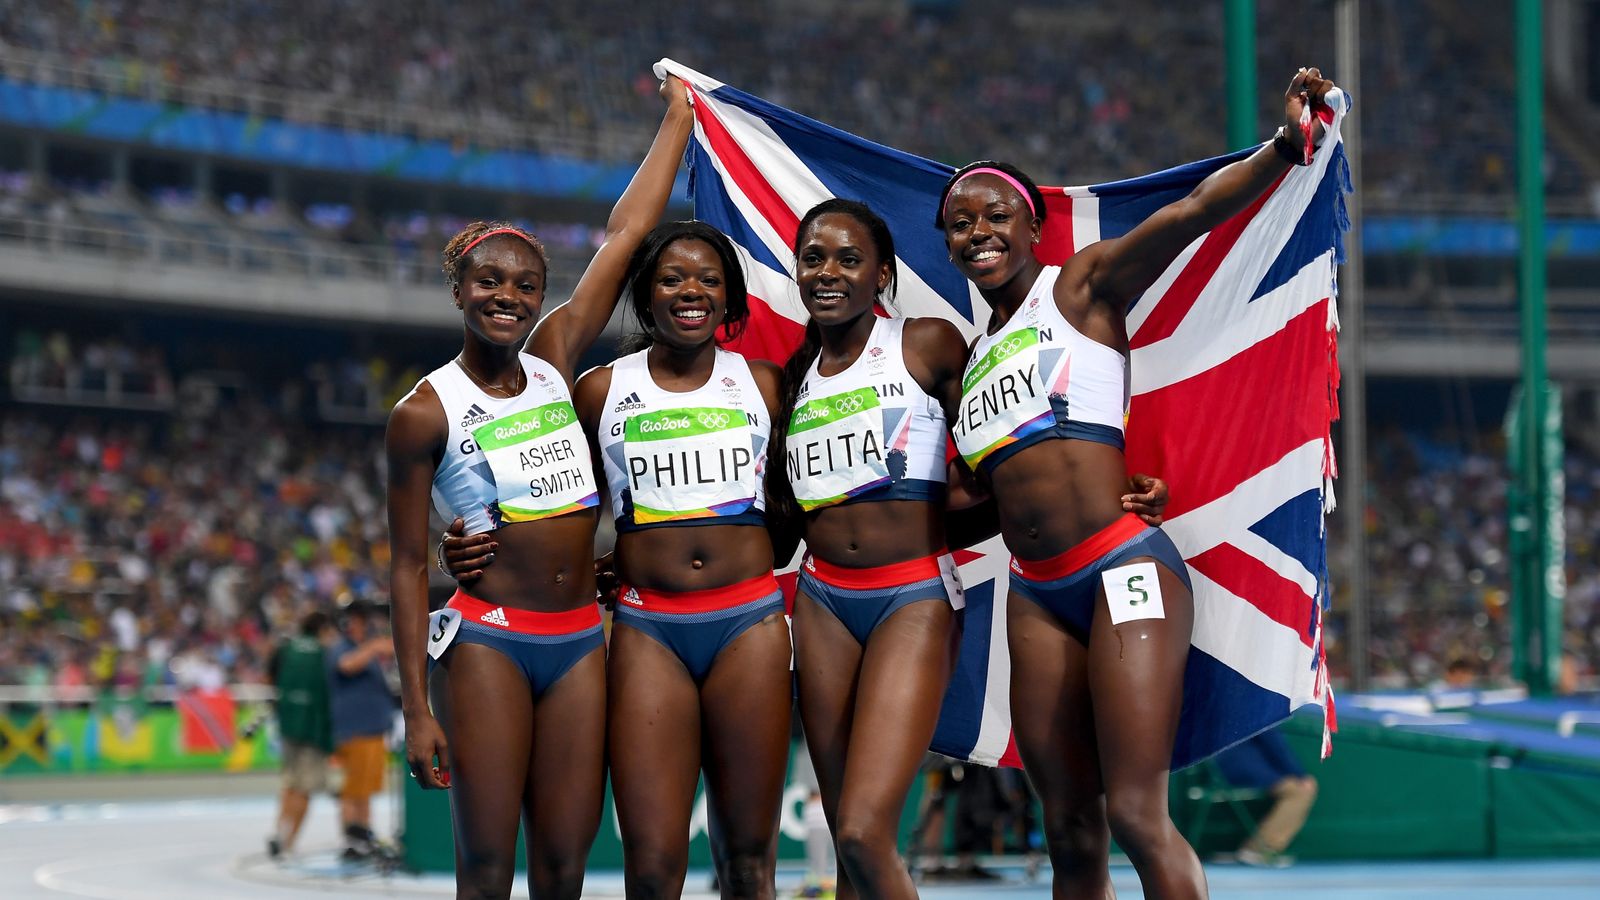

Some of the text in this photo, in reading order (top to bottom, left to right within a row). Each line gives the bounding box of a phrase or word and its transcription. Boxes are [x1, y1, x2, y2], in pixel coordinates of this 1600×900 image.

[614, 402, 646, 413] adidas
[954, 363, 1035, 443] HENRY
[461, 412, 495, 428] adidas
[494, 417, 541, 441] Rio2016
[640, 416, 690, 434] Rio2016
[519, 439, 575, 471] ASHER
[629, 447, 751, 490] PHILIP
[788, 429, 882, 483] NEITA
[530, 467, 585, 498] SMITH
[1127, 575, 1149, 606] S
[480, 614, 509, 627] adidas
